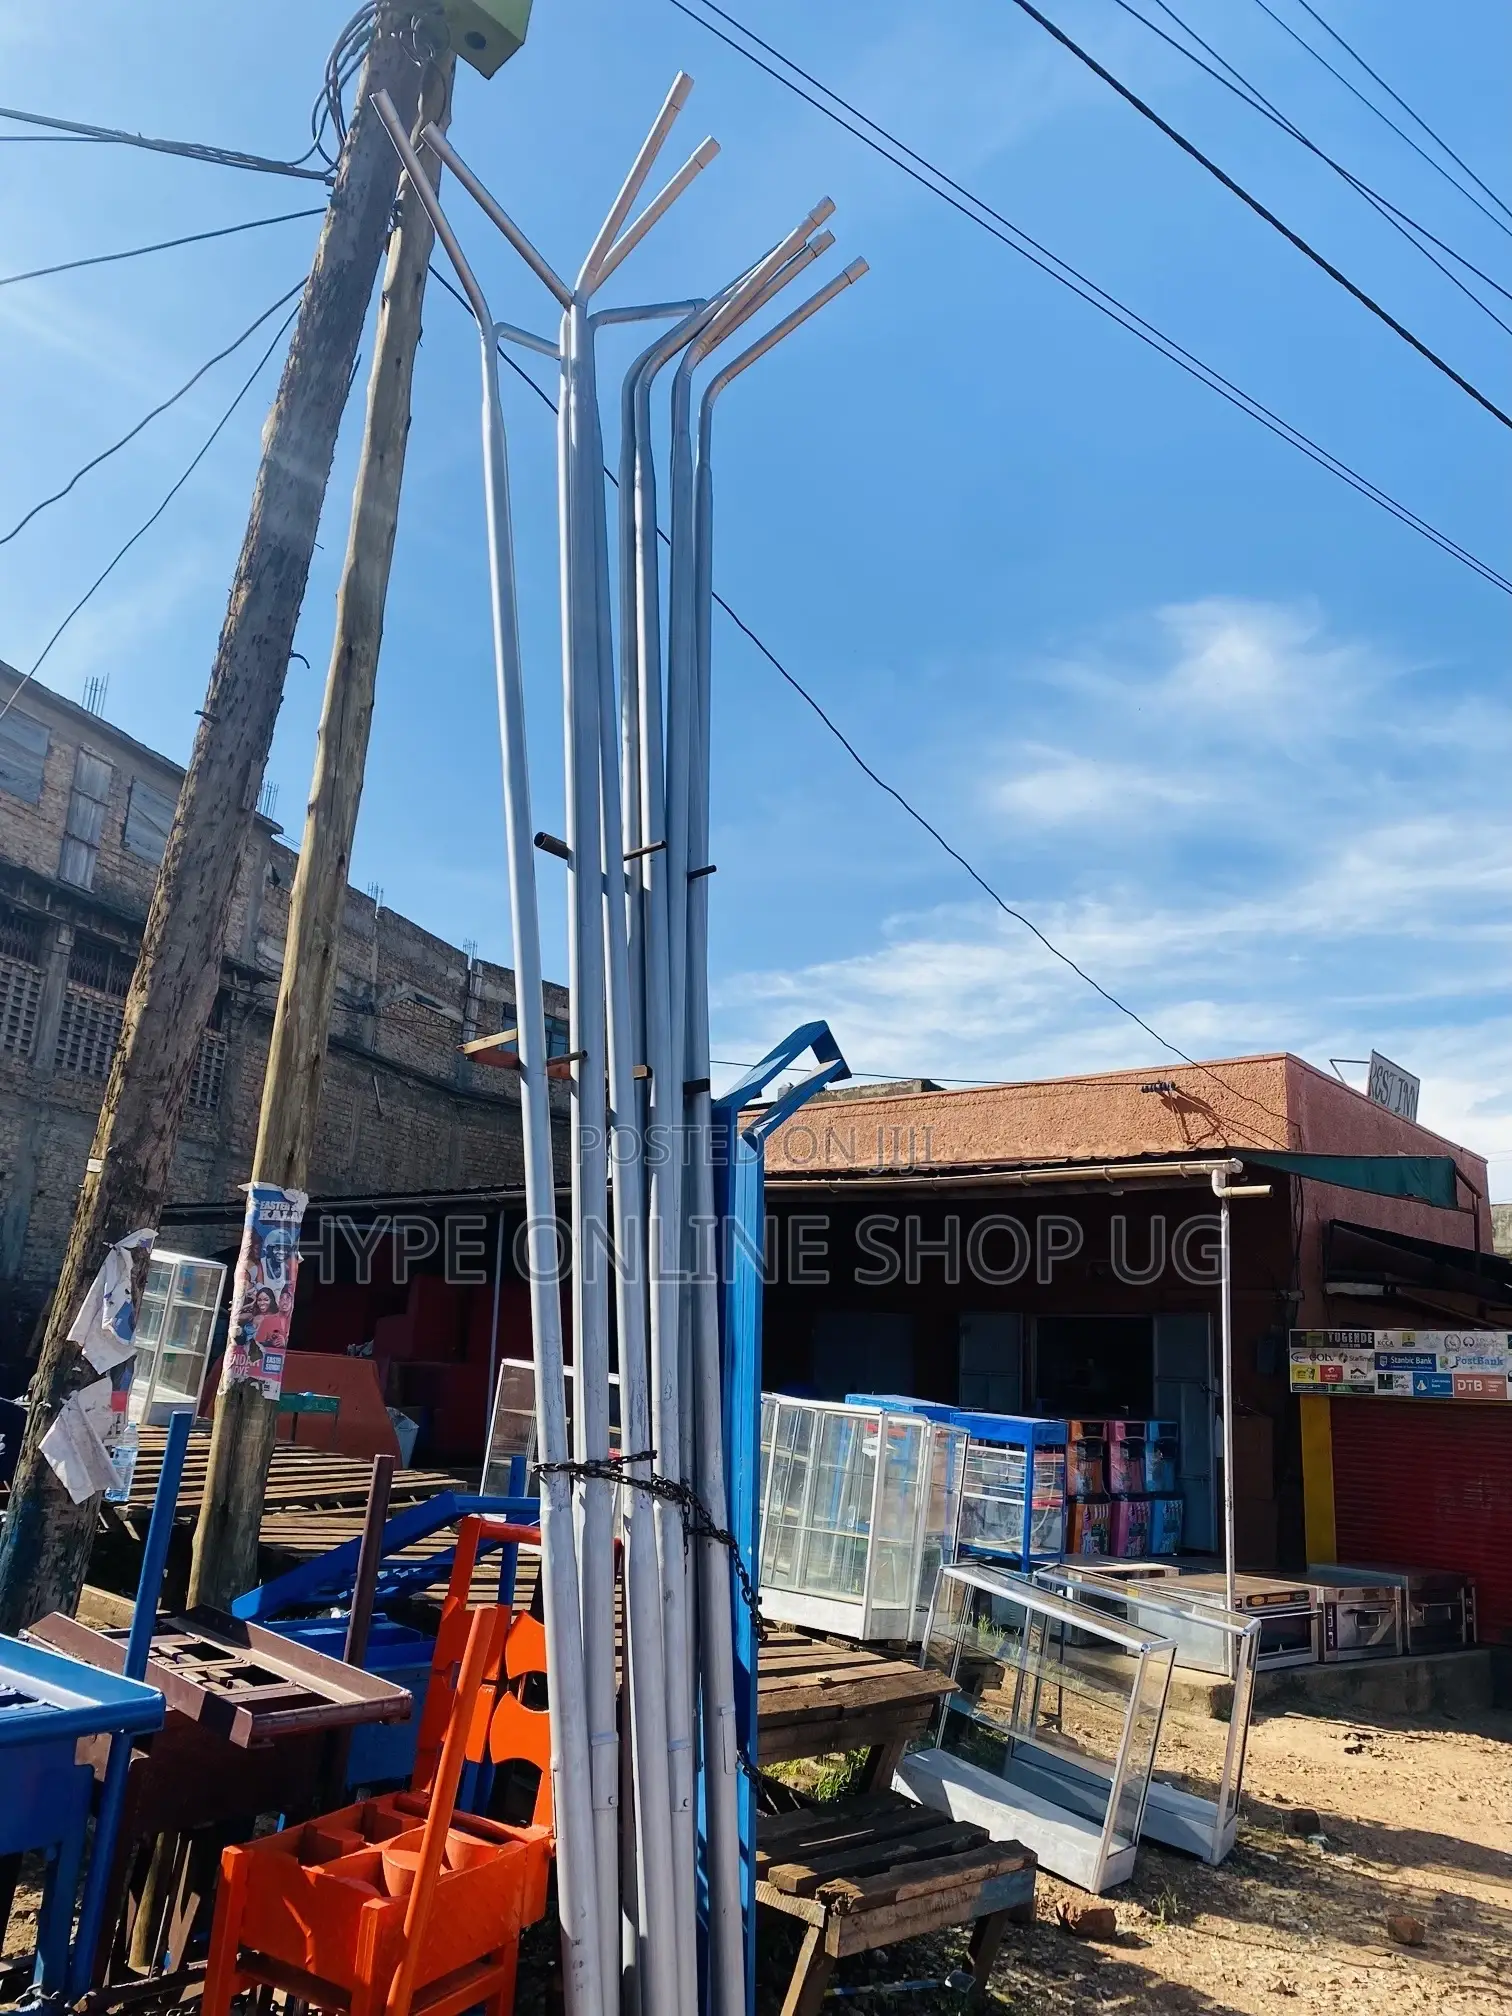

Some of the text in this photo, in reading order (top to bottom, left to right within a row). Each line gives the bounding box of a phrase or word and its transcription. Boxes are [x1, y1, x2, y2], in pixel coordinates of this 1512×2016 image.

[1368, 1060, 1420, 1123] REST INN
[1327, 1331, 1374, 1344] TUGENDE
[1390, 1356, 1433, 1365] Stanbic Bank
[1455, 1356, 1504, 1366] PostBank
[1457, 1379, 1483, 1391] DTB
